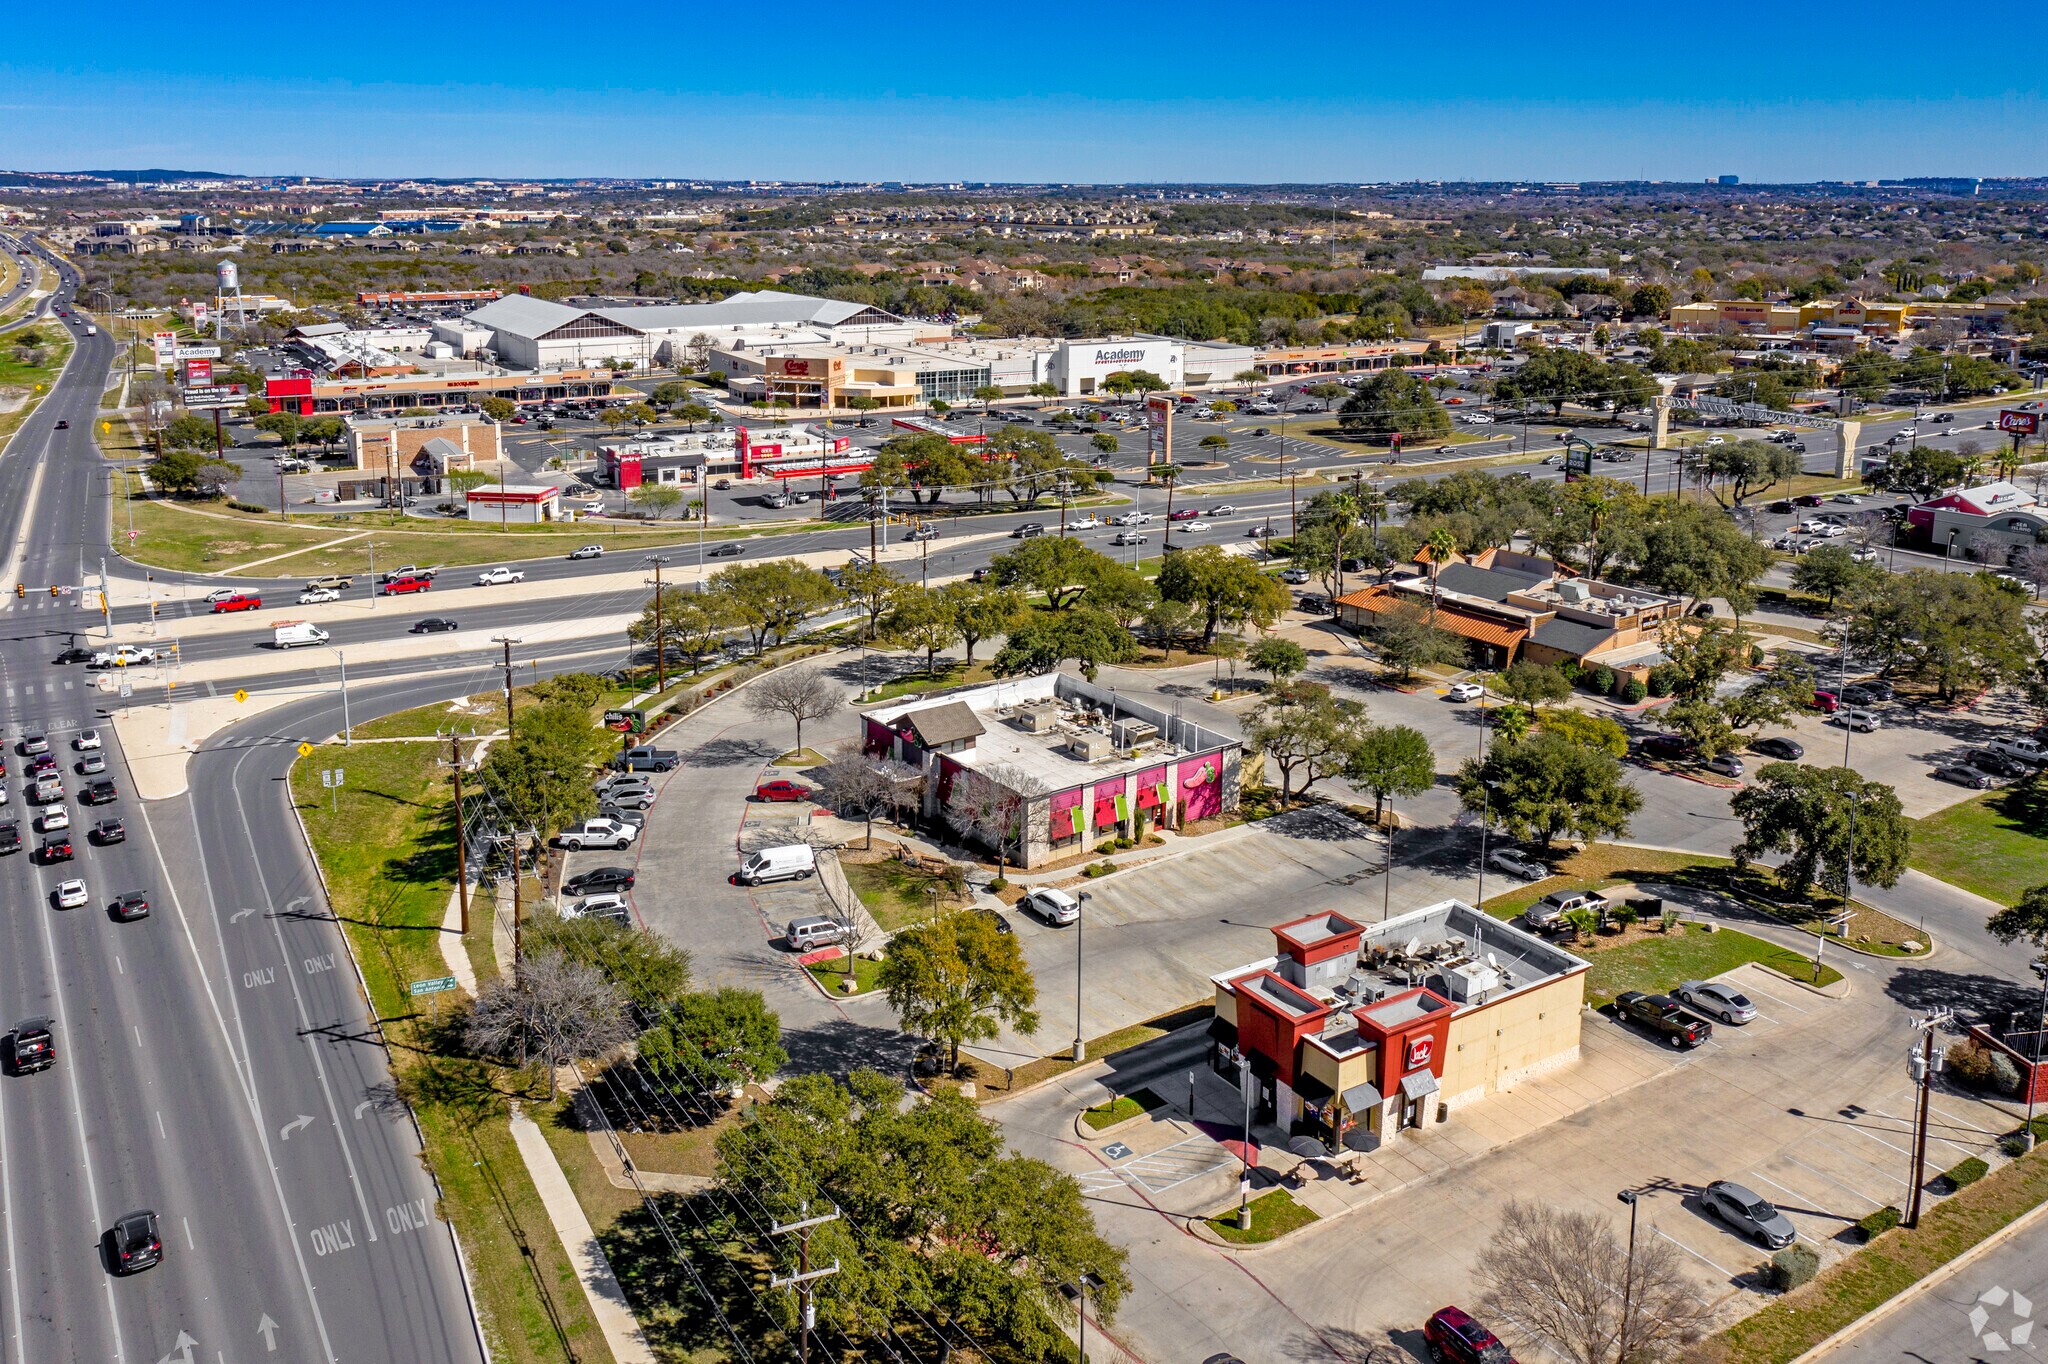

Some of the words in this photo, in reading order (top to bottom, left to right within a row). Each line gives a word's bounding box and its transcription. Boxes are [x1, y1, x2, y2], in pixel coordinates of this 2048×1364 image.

[179, 348, 216, 356] Academy
[1095, 348, 1146, 362] Academy
[2002, 414, 2032, 428] Cane's
[1569, 460, 1585, 468] ROSS
[2011, 525, 2032, 533] ISLAND
[605, 712, 623, 721] chili's
[48, 719, 78, 731] CLEAR
[304, 952, 337, 975] ONLY
[243, 966, 276, 989] ONLY
[1411, 1043, 1430, 1063] Jack
[386, 1198, 430, 1235] ONLY
[310, 1218, 356, 1256] ONLY
